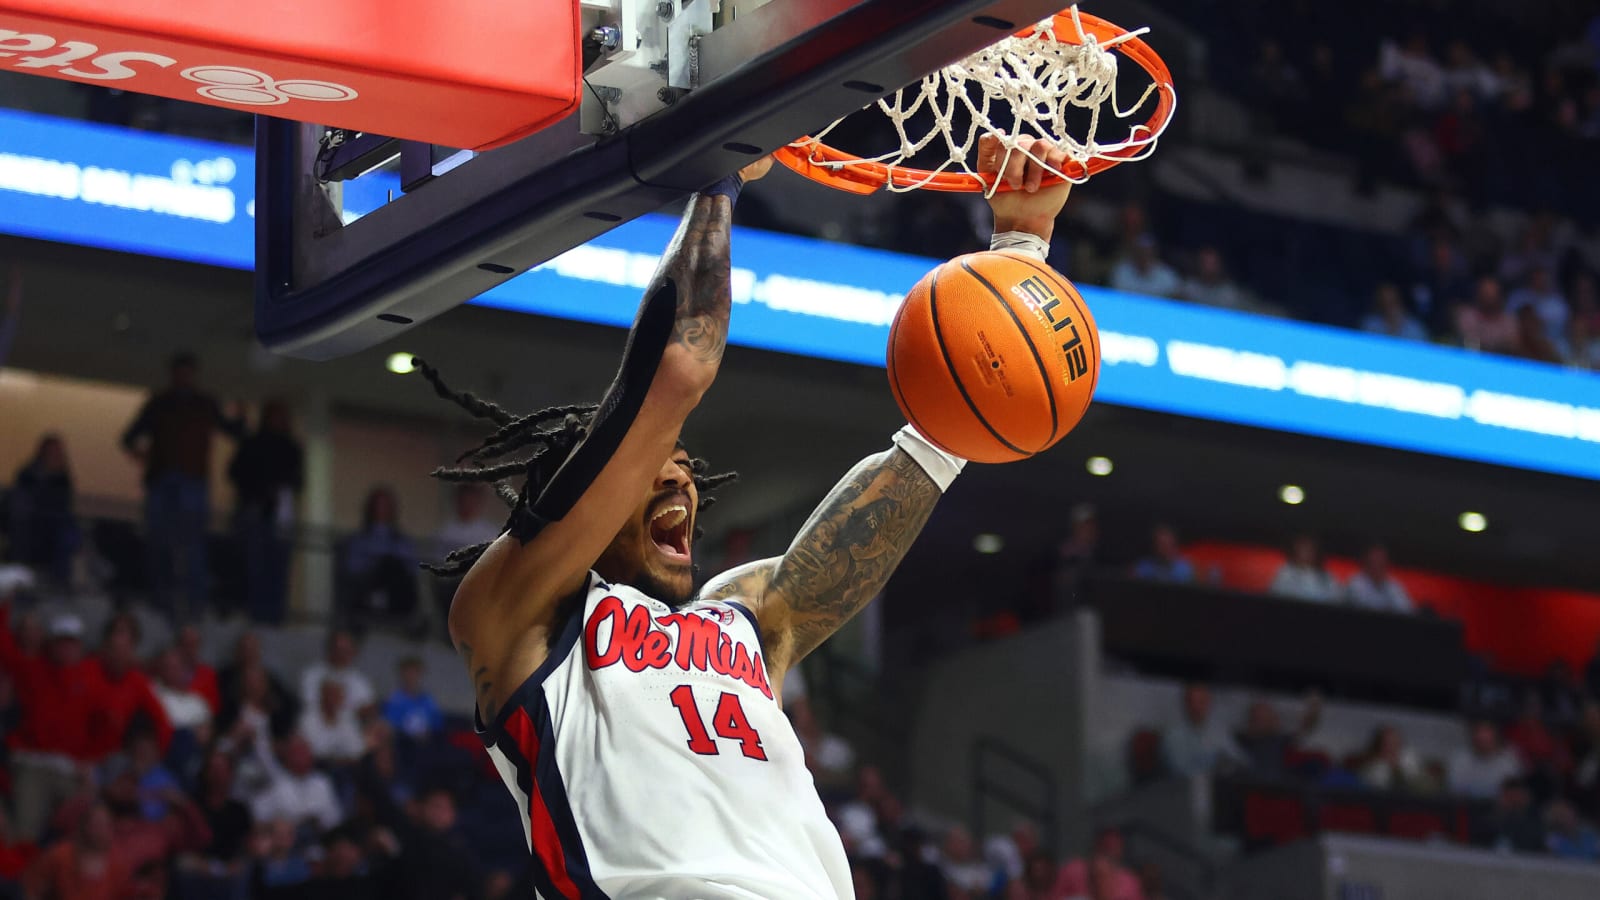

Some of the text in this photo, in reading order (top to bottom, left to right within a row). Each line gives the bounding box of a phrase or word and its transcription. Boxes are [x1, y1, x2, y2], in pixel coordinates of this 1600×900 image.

[1019, 275, 1088, 382] ELITE
[584, 595, 774, 701] Ole Miss
[669, 684, 769, 762] 14
